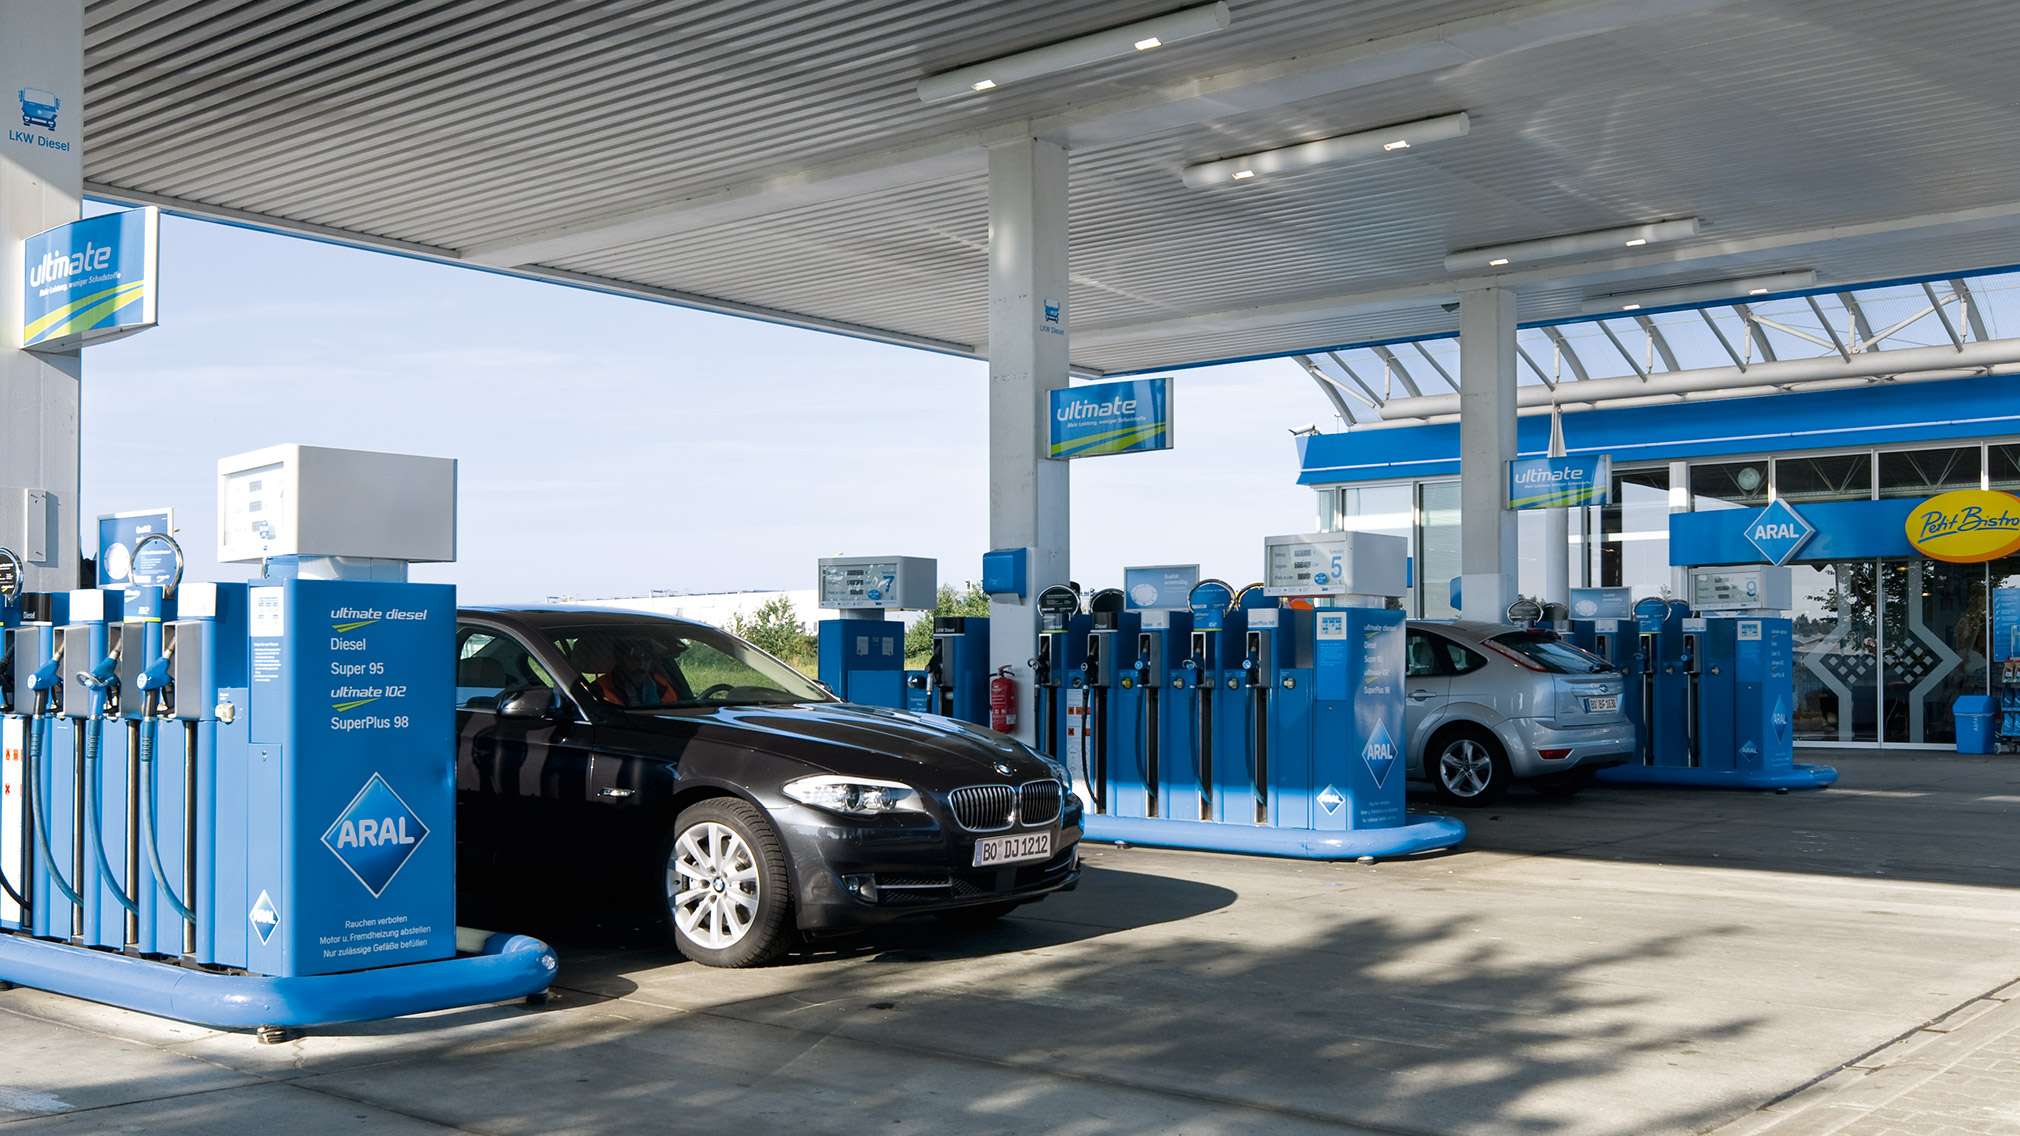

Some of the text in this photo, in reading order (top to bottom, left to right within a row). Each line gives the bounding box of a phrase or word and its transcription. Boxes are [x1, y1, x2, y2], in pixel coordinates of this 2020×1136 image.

[9, 129, 70, 151] LKW Diesel
[30, 241, 112, 288] ultimate
[1057, 396, 1137, 421] ultimate
[1515, 466, 1584, 484] ultimate
[1922, 506, 2020, 538] Petit Bistro
[1754, 523, 1799, 540] ARAL
[1331, 556, 1342, 578] 5
[883, 575, 895, 592] 7
[1746, 580, 1757, 597] 9
[330, 607, 428, 620] ultimate diesel
[330, 637, 366, 651] Diesel
[330, 662, 384, 677] Super 95
[330, 685, 407, 698] ultimate 102
[331, 716, 409, 732] SuperPlus 98
[1367, 743, 1393, 760] ARAL
[337, 816, 415, 849] ARAL
[983, 835, 1048, 861] BO DJ 1212
[345, 914, 408, 929] Rauchen verboten
[320, 936, 341, 945] Motor
[350, 928, 400, 941] Fremdheizung
[400, 925, 432, 936] abstellen
[323, 938, 428, 958] Nur zulässige Gefäße befüllen
